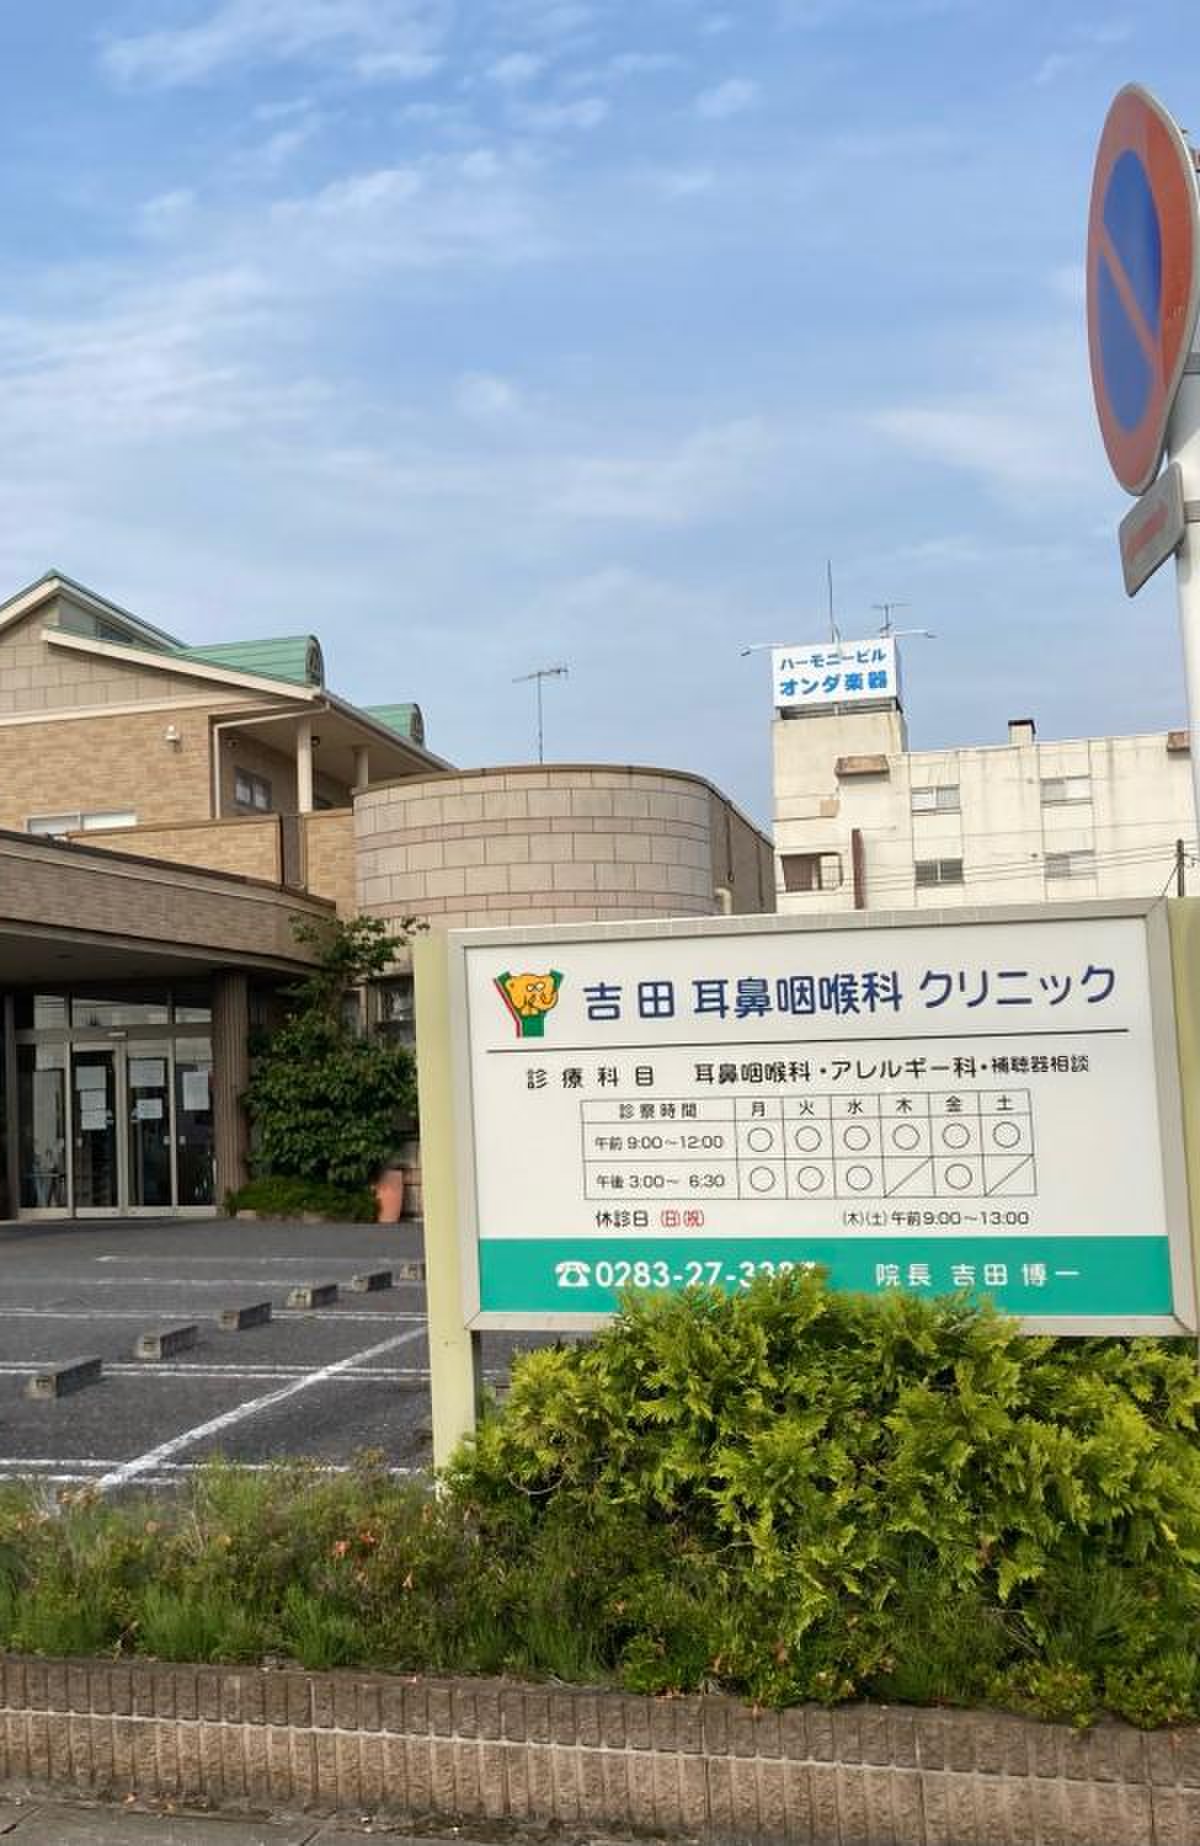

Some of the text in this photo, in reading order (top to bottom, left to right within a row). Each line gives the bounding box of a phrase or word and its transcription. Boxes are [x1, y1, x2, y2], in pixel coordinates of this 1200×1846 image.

[781, 648, 887, 670] ハーモニービル
[779, 670, 887, 696] オンダ楽器
[583, 965, 1115, 1021] 吉田 耳鼻咽喉科 クリニック
[527, 1065, 655, 1090] 診療科目
[619, 1094, 1015, 1119] 診察時間 月 火 水 木 金 土
[595, 1136, 622, 1151] 午前
[597, 1175, 624, 1189] 午後
[596, 1210, 649, 1227] 休診日
[875, 1263, 1081, 1287] 院長 吉田 博一
